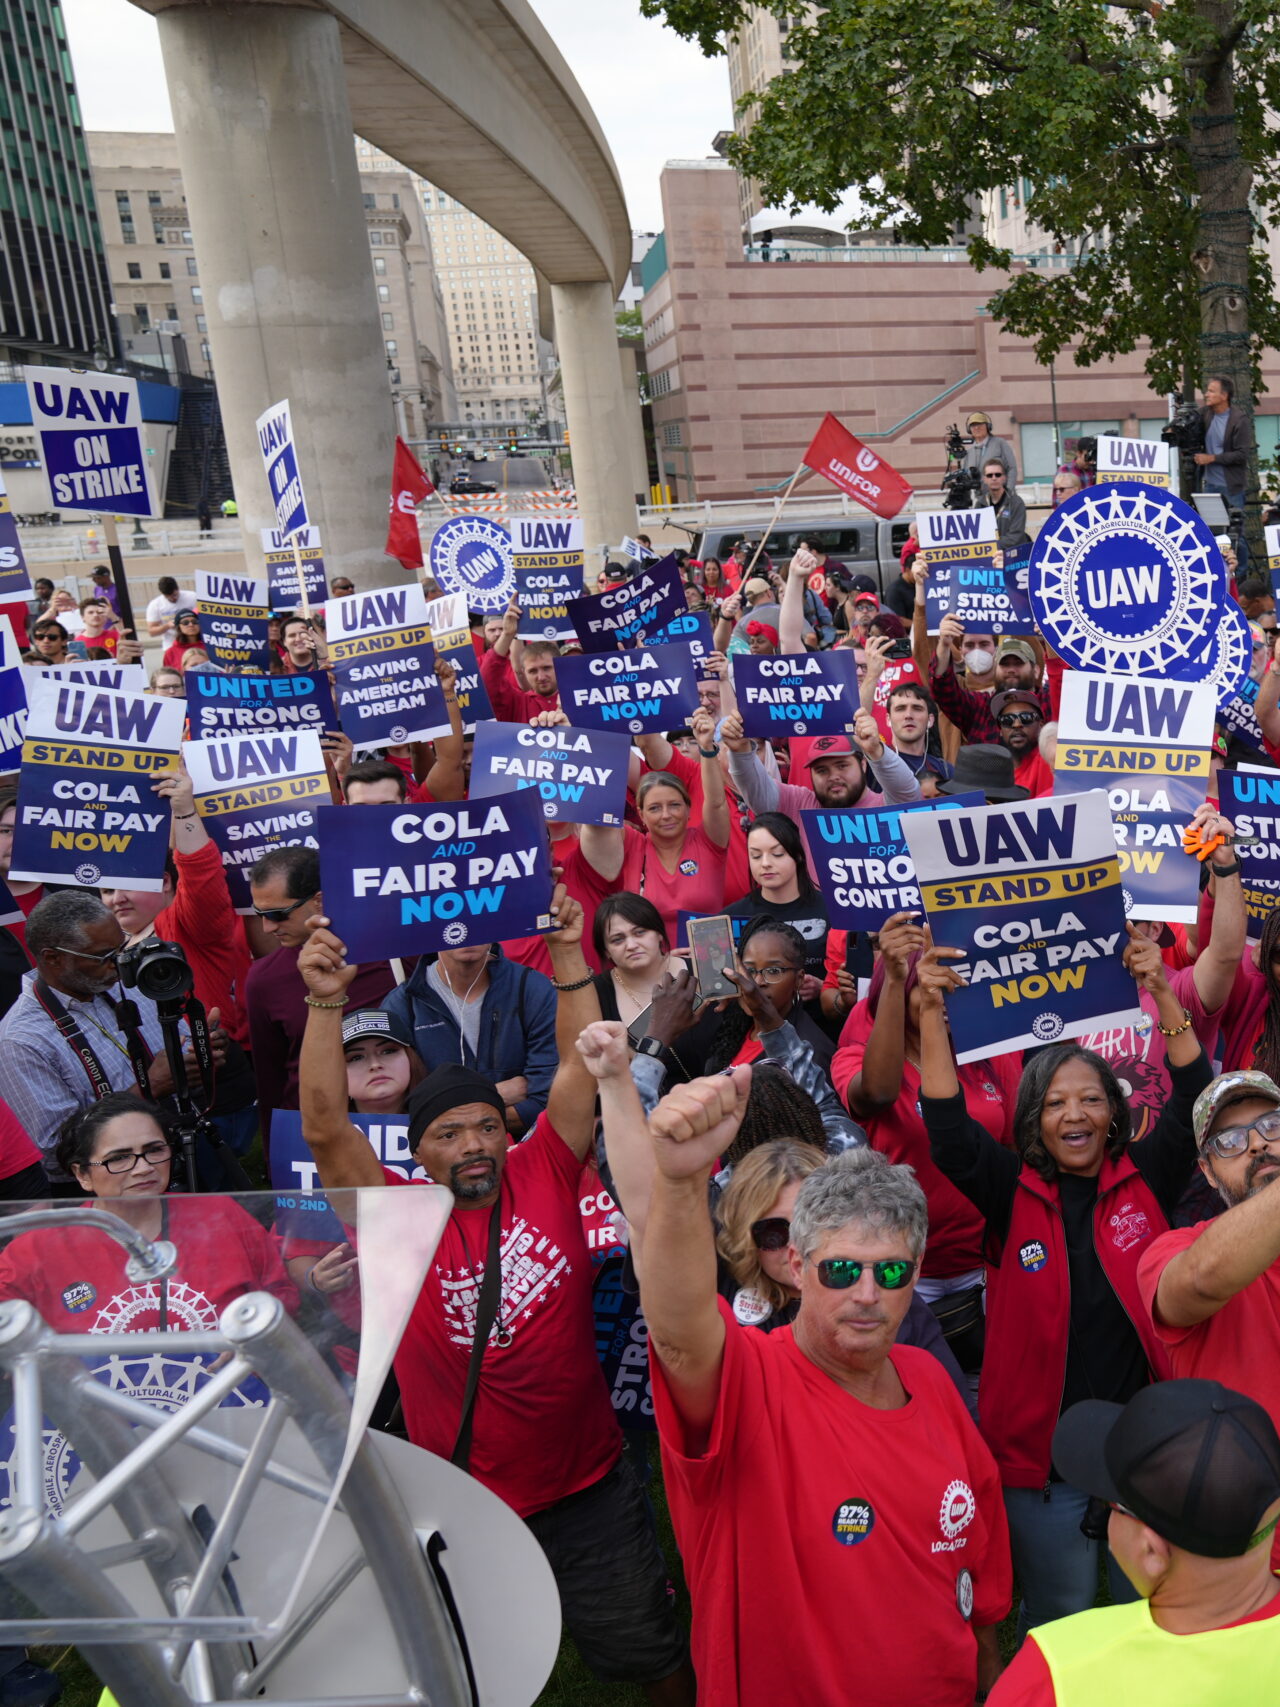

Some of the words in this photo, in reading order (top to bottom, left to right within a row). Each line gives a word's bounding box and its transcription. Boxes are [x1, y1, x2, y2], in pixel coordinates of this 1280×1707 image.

[33, 382, 129, 424] UAW
[0, 436, 34, 445] ORT
[260, 412, 287, 453] UAW
[74, 435, 111, 467] ON
[1110, 442, 1158, 468] UAW
[274, 457, 287, 494] ON
[1146, 475, 1164, 485] UP
[277, 475, 301, 534] STRIKE
[521, 522, 571, 549] UAW
[929, 513, 981, 541] UAW
[1085, 528, 1099, 539] AND
[1101, 521, 1151, 532] AGRICULTURAL
[925, 549, 971, 561] STAND
[1152, 530, 1181, 562] IMPLEMENT
[516, 555, 559, 566] STAND
[1065, 541, 1084, 576] AEROSPACE
[207, 575, 255, 602] UAW
[1085, 565, 1161, 609] UAW
[1180, 565, 1188, 600] WORKERS
[640, 583, 671, 613] PAY
[1179, 603, 1185, 612] OF
[201, 605, 242, 616] STAND
[341, 591, 406, 631] UAW
[401, 631, 425, 644] UP
[1081, 625, 1102, 644] UNITED
[1157, 615, 1180, 639] AMERICA
[348, 657, 420, 682] SAVING
[589, 653, 658, 677] COLA
[759, 658, 822, 677] COLA
[198, 677, 315, 699] UNITED
[574, 682, 634, 706] FAIR
[639, 677, 682, 697] PAY
[800, 684, 844, 702] PAY
[55, 687, 163, 743] UAW
[201, 704, 321, 726] STRONG
[358, 693, 426, 719] DREAM
[1085, 680, 1193, 739] UAW
[207, 736, 297, 781] UAW
[1166, 752, 1201, 771] UP
[53, 780, 141, 804] COLA
[290, 778, 321, 794] UP
[22, 805, 96, 829] FAIR
[103, 813, 165, 833] PAY
[226, 810, 313, 841] SAVING
[391, 805, 510, 844] COLA
[938, 804, 1077, 867] UAW
[869, 846, 896, 856] FOR
[353, 862, 456, 897] FAIR
[1062, 868, 1108, 892] UP
[973, 912, 1086, 948] COLA
[1047, 932, 1121, 964] PAY
[990, 965, 1086, 1008] NOW
[81, 1048, 101, 1081] Canon
[199, 1040, 209, 1068] DIGITAL
[276, 1198, 296, 1208] NO
[300, 1200, 327, 1211] 2ND
[1020, 1243, 1042, 1256] 97%
[1022, 1252, 1037, 1262] READY
[1024, 1254, 1045, 1266] STRIKE
[64, 1283, 88, 1300] 97%
[513, 1262, 547, 1303] EVER
[66, 1295, 83, 1305] READY
[68, 1294, 93, 1308] STRIKE
[123, 1389, 173, 1397] CULTURAL
[46, 1433, 65, 1472] AEROSPA
[839, 1505, 869, 1519] 97%
[951, 1503, 966, 1516] UAW
[837, 1525, 867, 1533] STRIKE
[932, 1541, 954, 1553] LOCA
